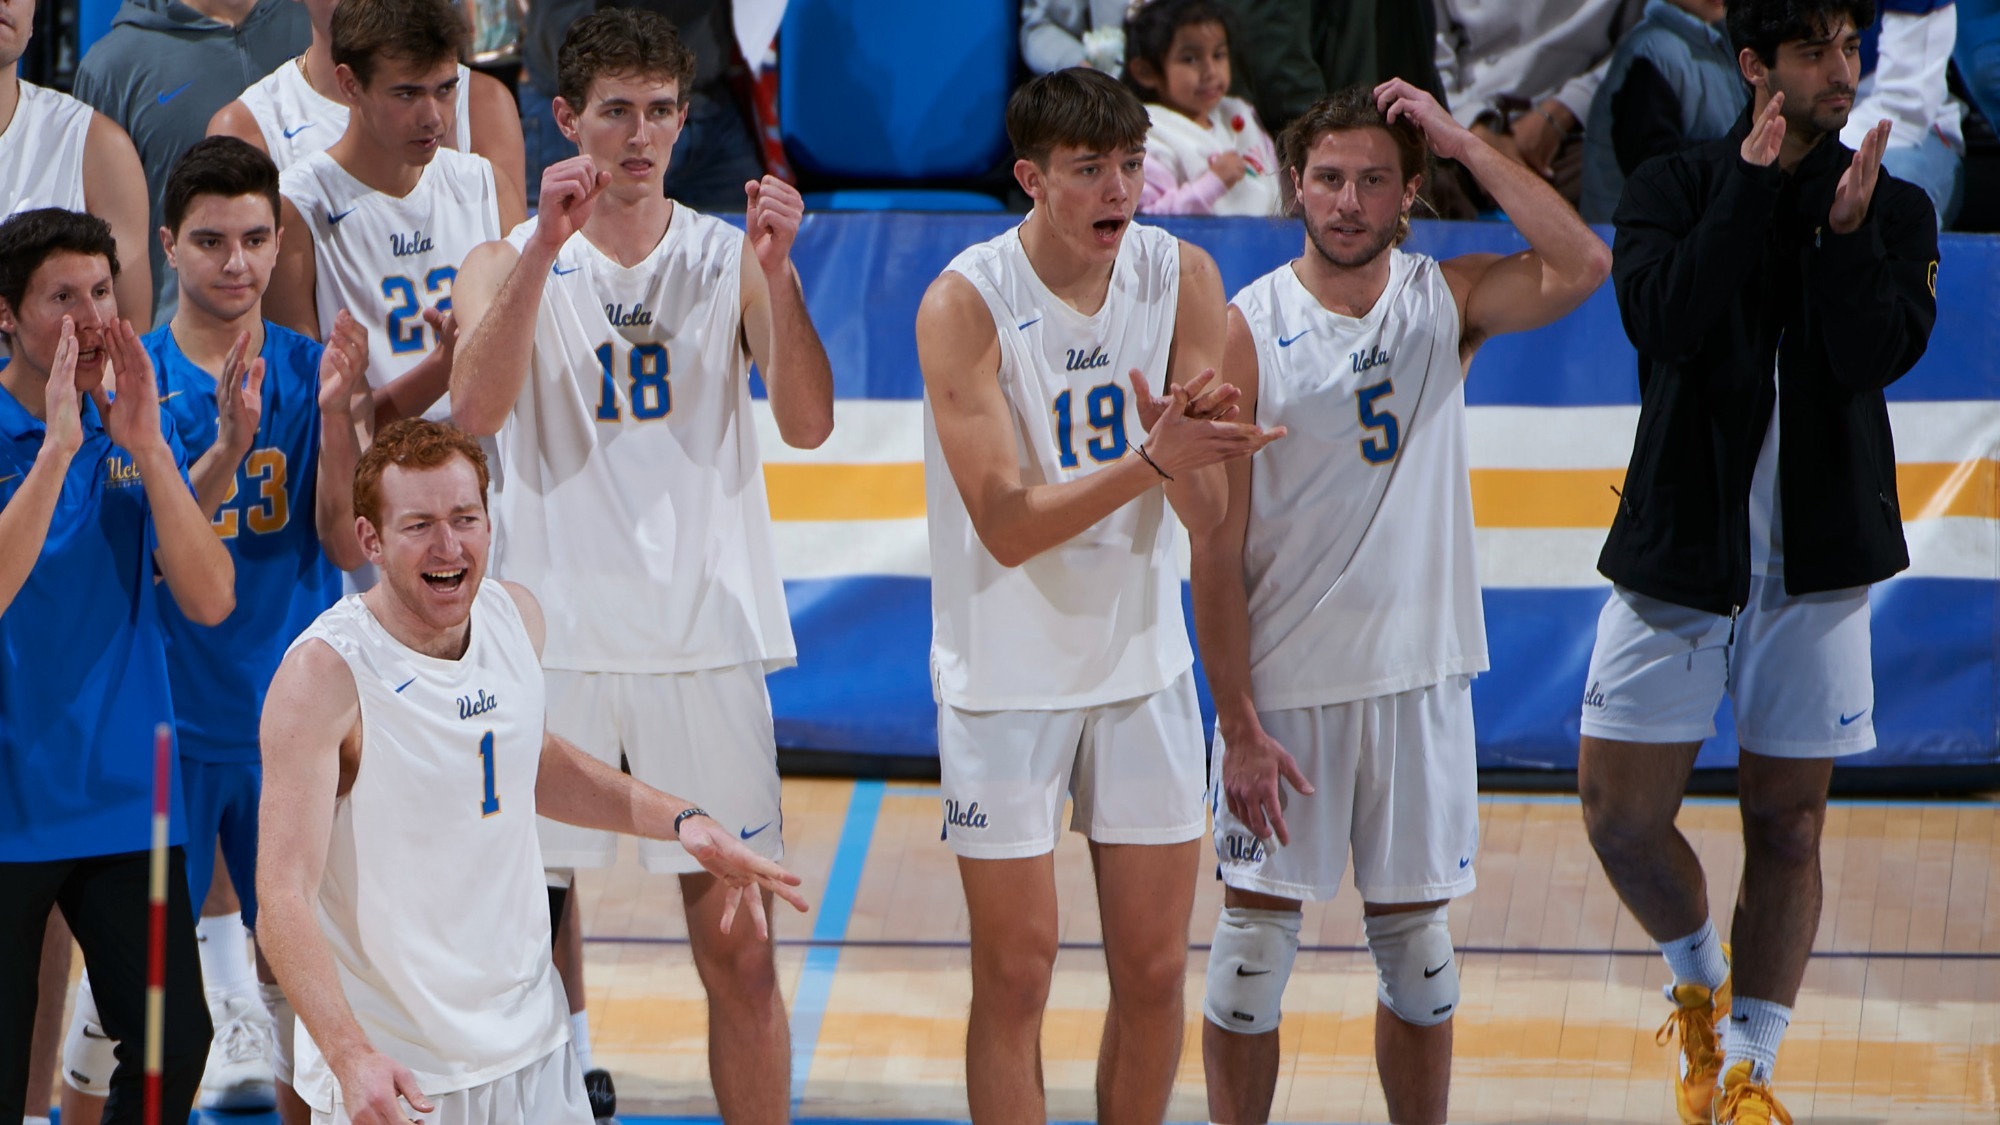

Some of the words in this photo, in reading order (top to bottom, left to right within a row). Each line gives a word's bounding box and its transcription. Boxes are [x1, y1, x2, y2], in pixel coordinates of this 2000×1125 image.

[389, 229, 434, 257] Ucla
[606, 303, 653, 326] Ucla
[1066, 345, 1110, 371] Ucla
[1349, 344, 1390, 374] Ucla
[594, 340, 673, 423] 18
[1052, 381, 1131, 471] 19
[1354, 377, 1402, 468] 5
[106, 456, 141, 480] Ucl
[456, 688, 498, 720] Ucla
[478, 729, 502, 819] 1
[945, 798, 989, 829] Ucla
[1226, 834, 1264, 863] Ucla
